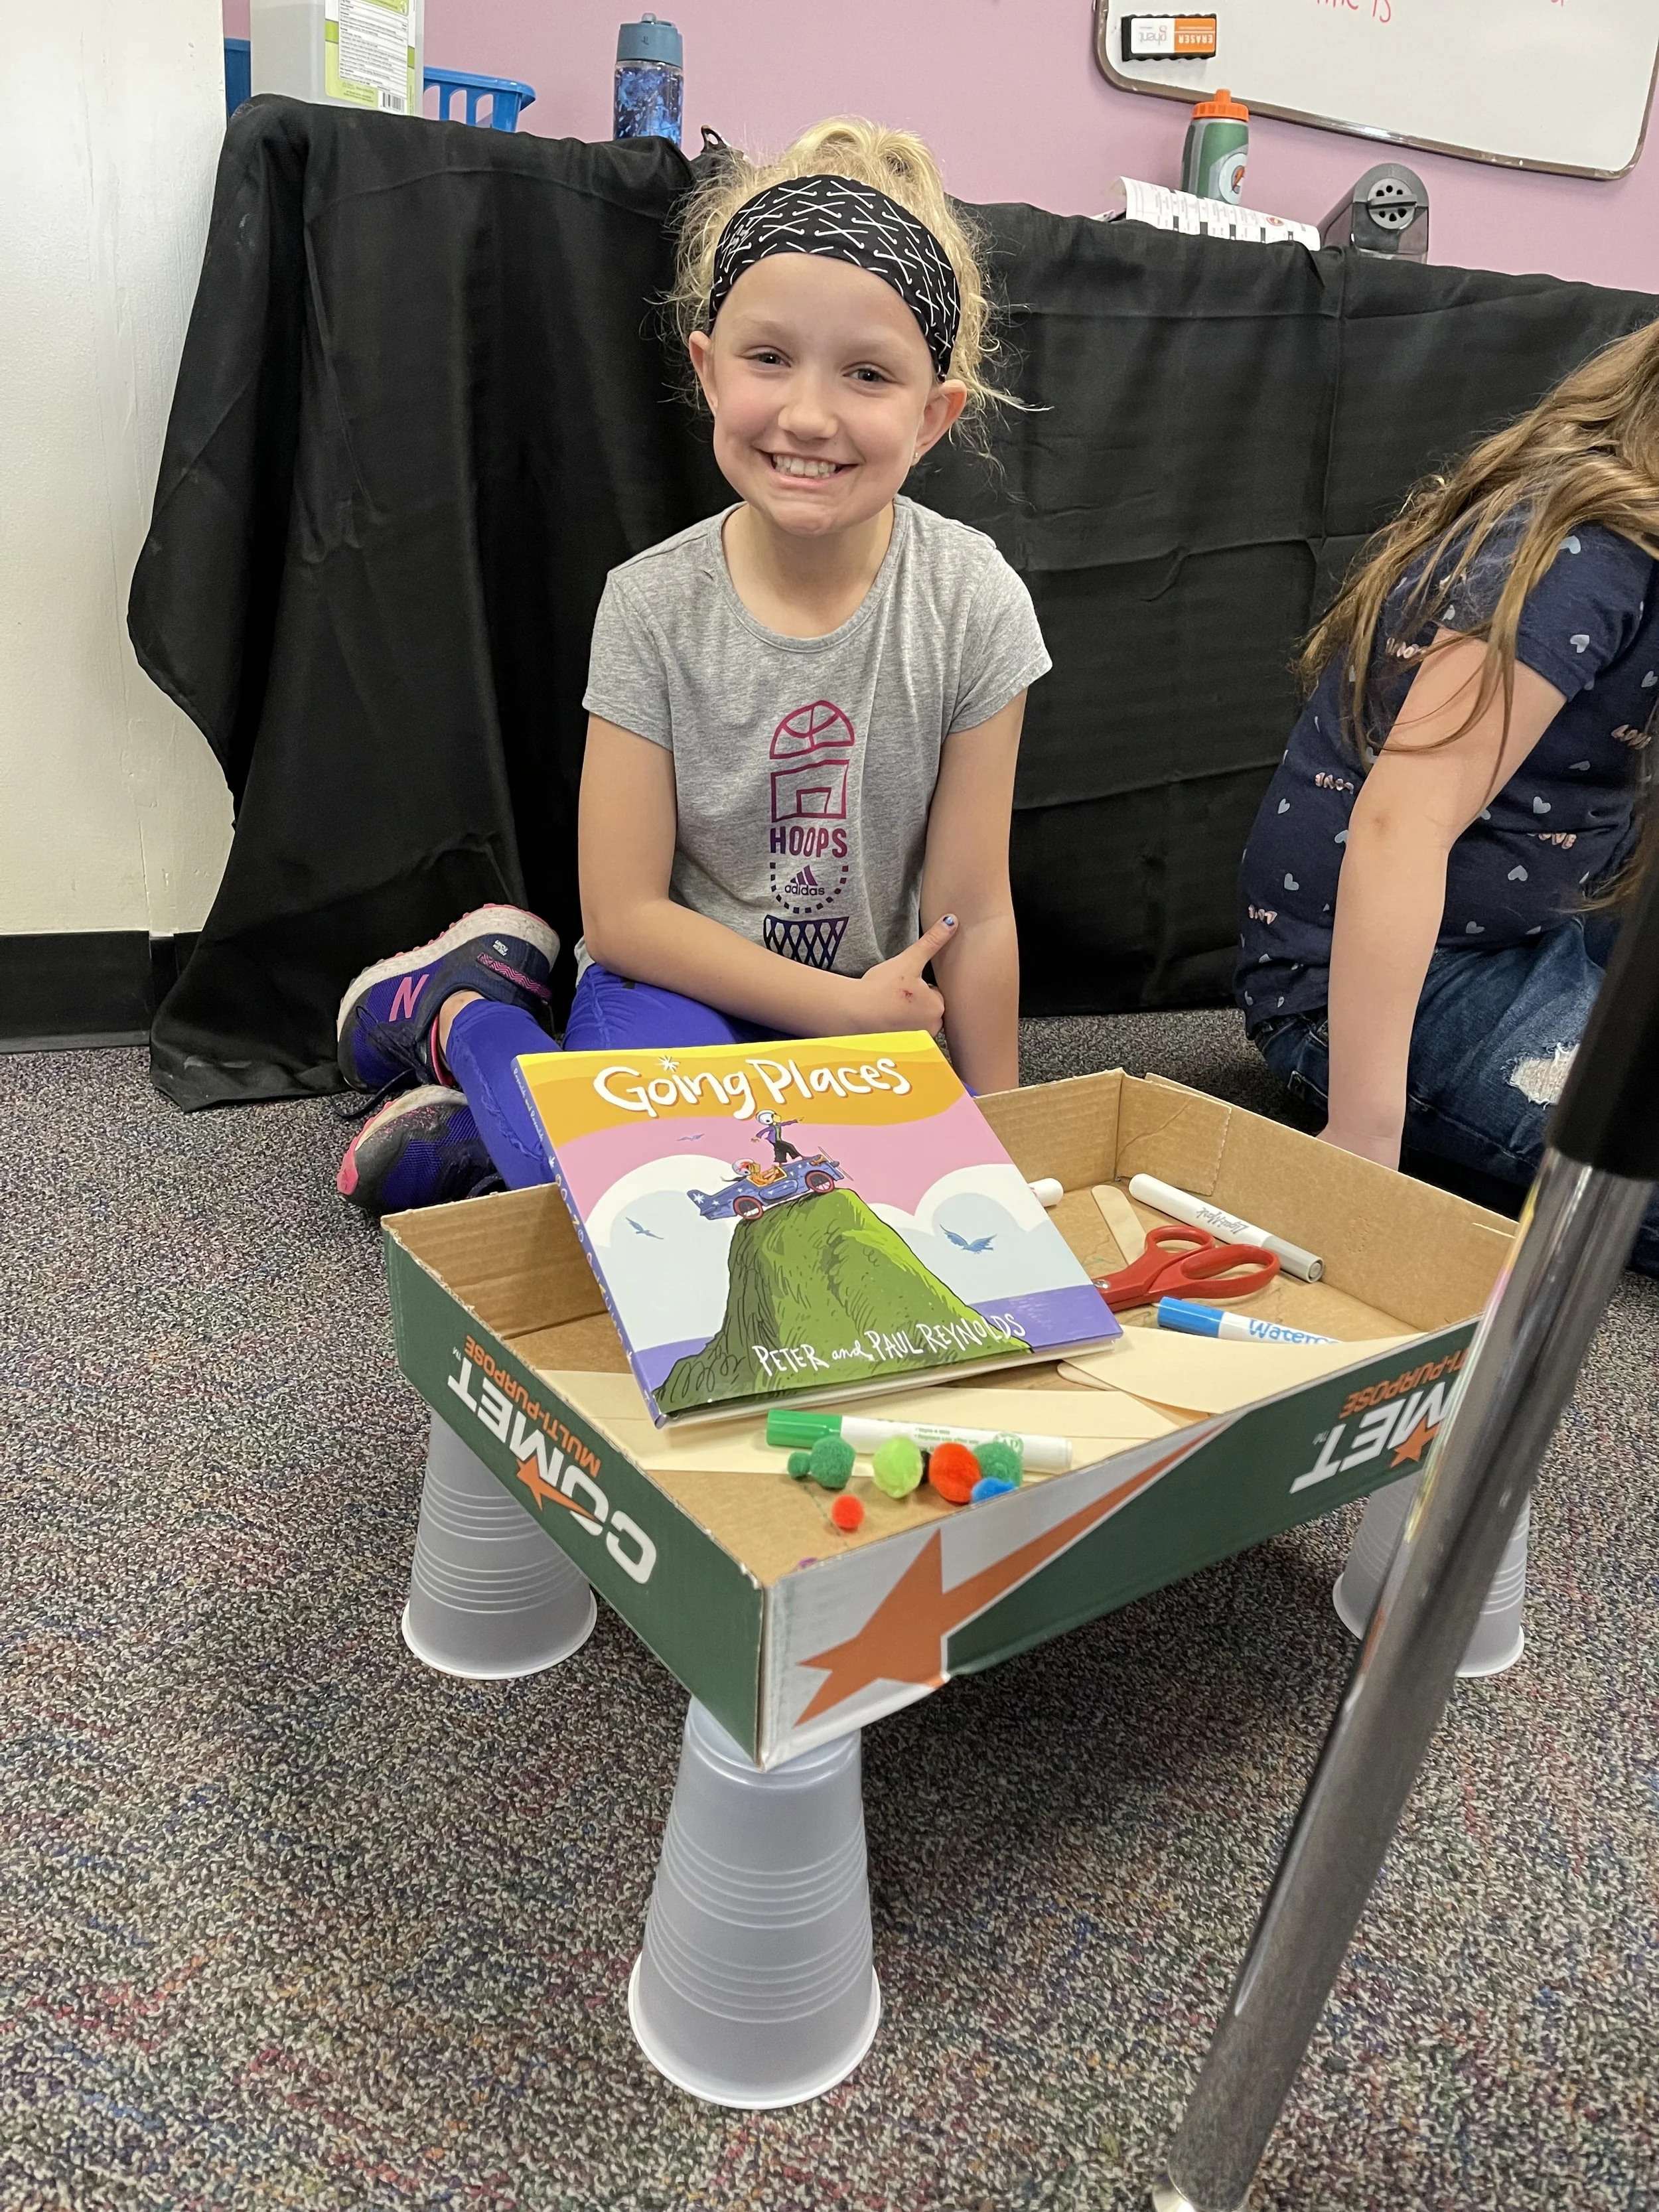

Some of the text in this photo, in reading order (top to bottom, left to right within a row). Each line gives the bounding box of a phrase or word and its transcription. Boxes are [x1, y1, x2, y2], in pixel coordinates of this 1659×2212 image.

[1177, 34, 1214, 44] ERASER
[770, 826, 847, 858] HOOPS
[784, 883, 825, 895] adidas
[388, 974, 429, 1022] N
[593, 1055, 912, 1120] Going Places
[751, 1313, 1027, 1376] PETER and PAUL REYNOLDS
[465, 1335, 601, 1478] MULTI-PURPOSE
[1289, 1379, 1457, 1494] MET
[447, 1357, 657, 1584] COMET
